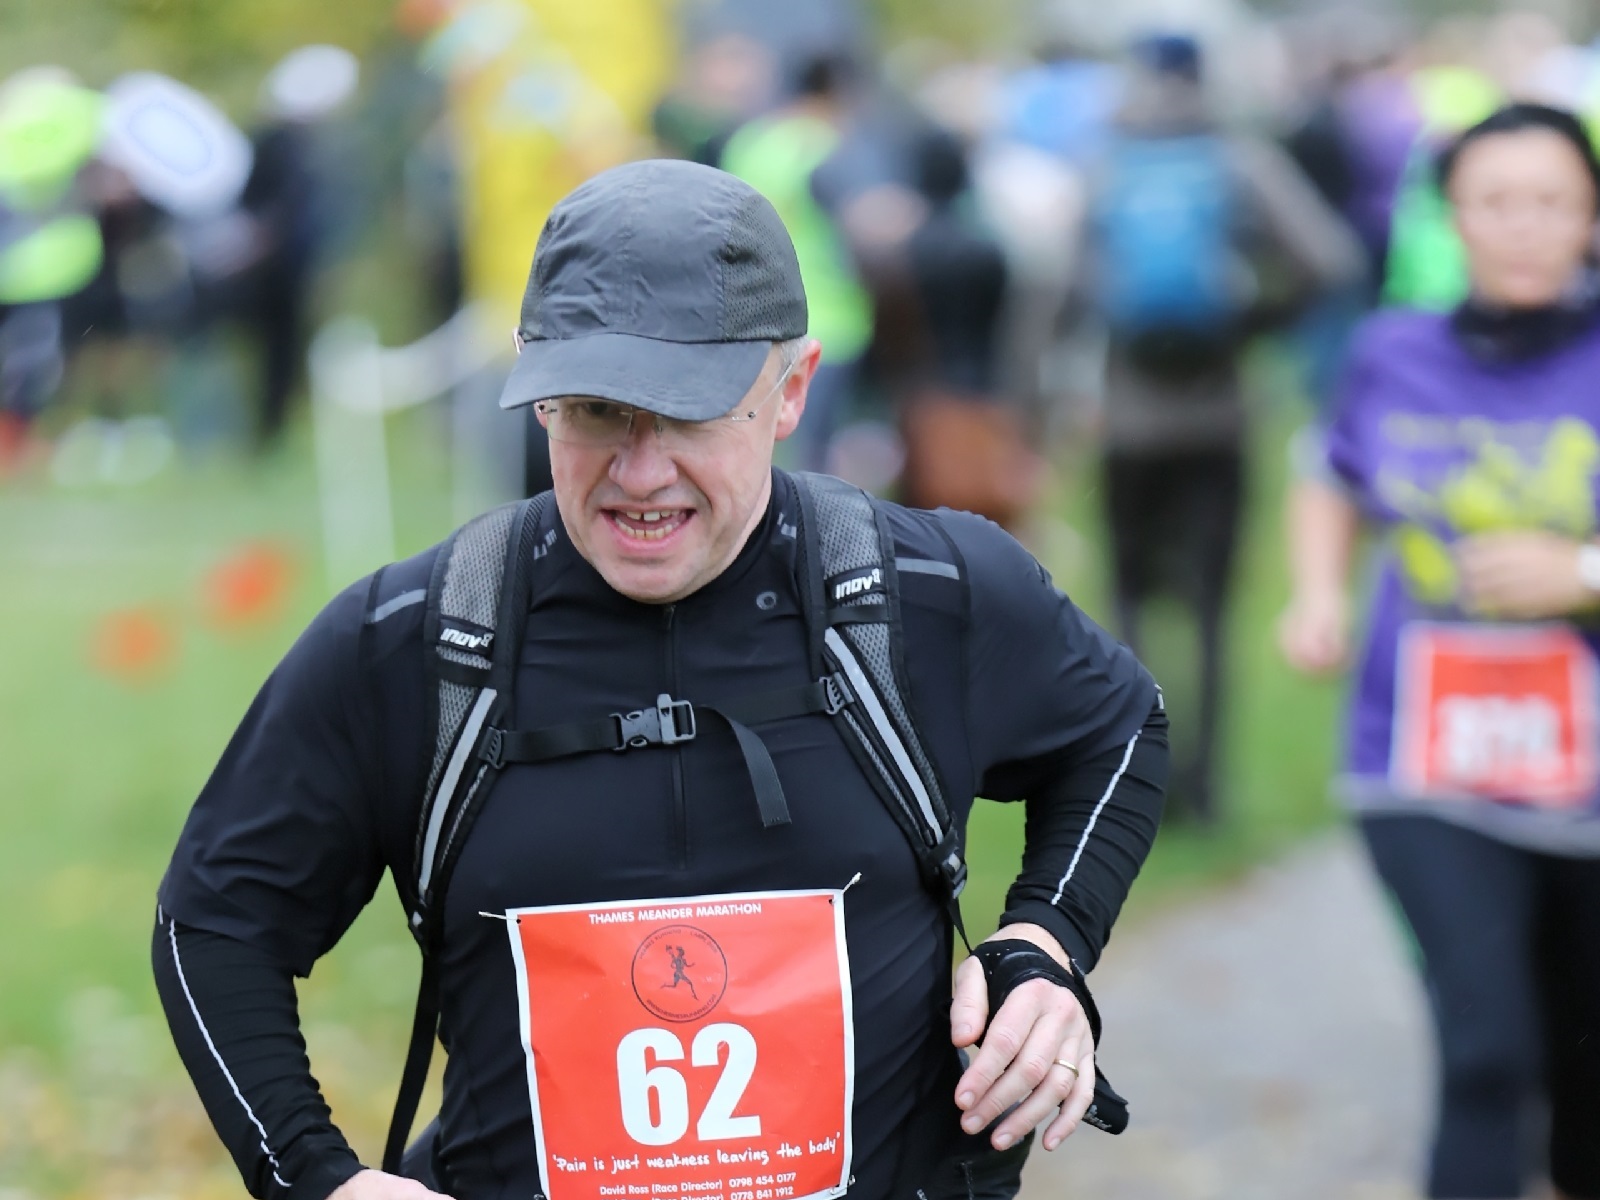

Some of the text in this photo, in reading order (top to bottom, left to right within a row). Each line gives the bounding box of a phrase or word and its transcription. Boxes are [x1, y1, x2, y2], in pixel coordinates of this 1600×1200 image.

[589, 903, 762, 924] THAMES MEANDER MARATHON
[616, 1022, 762, 1146] 62
[593, 1156, 605, 1171] is
[611, 1153, 640, 1175] just
[646, 1152, 710, 1168] weakness
[716, 1147, 770, 1166] leaving
[776, 1142, 802, 1158] the
[600, 1172, 797, 1196] David Ross (Race Director) 0798 454 0177
[756, 1188, 773, 1200] 841
[775, 1186, 794, 1197] 1912
